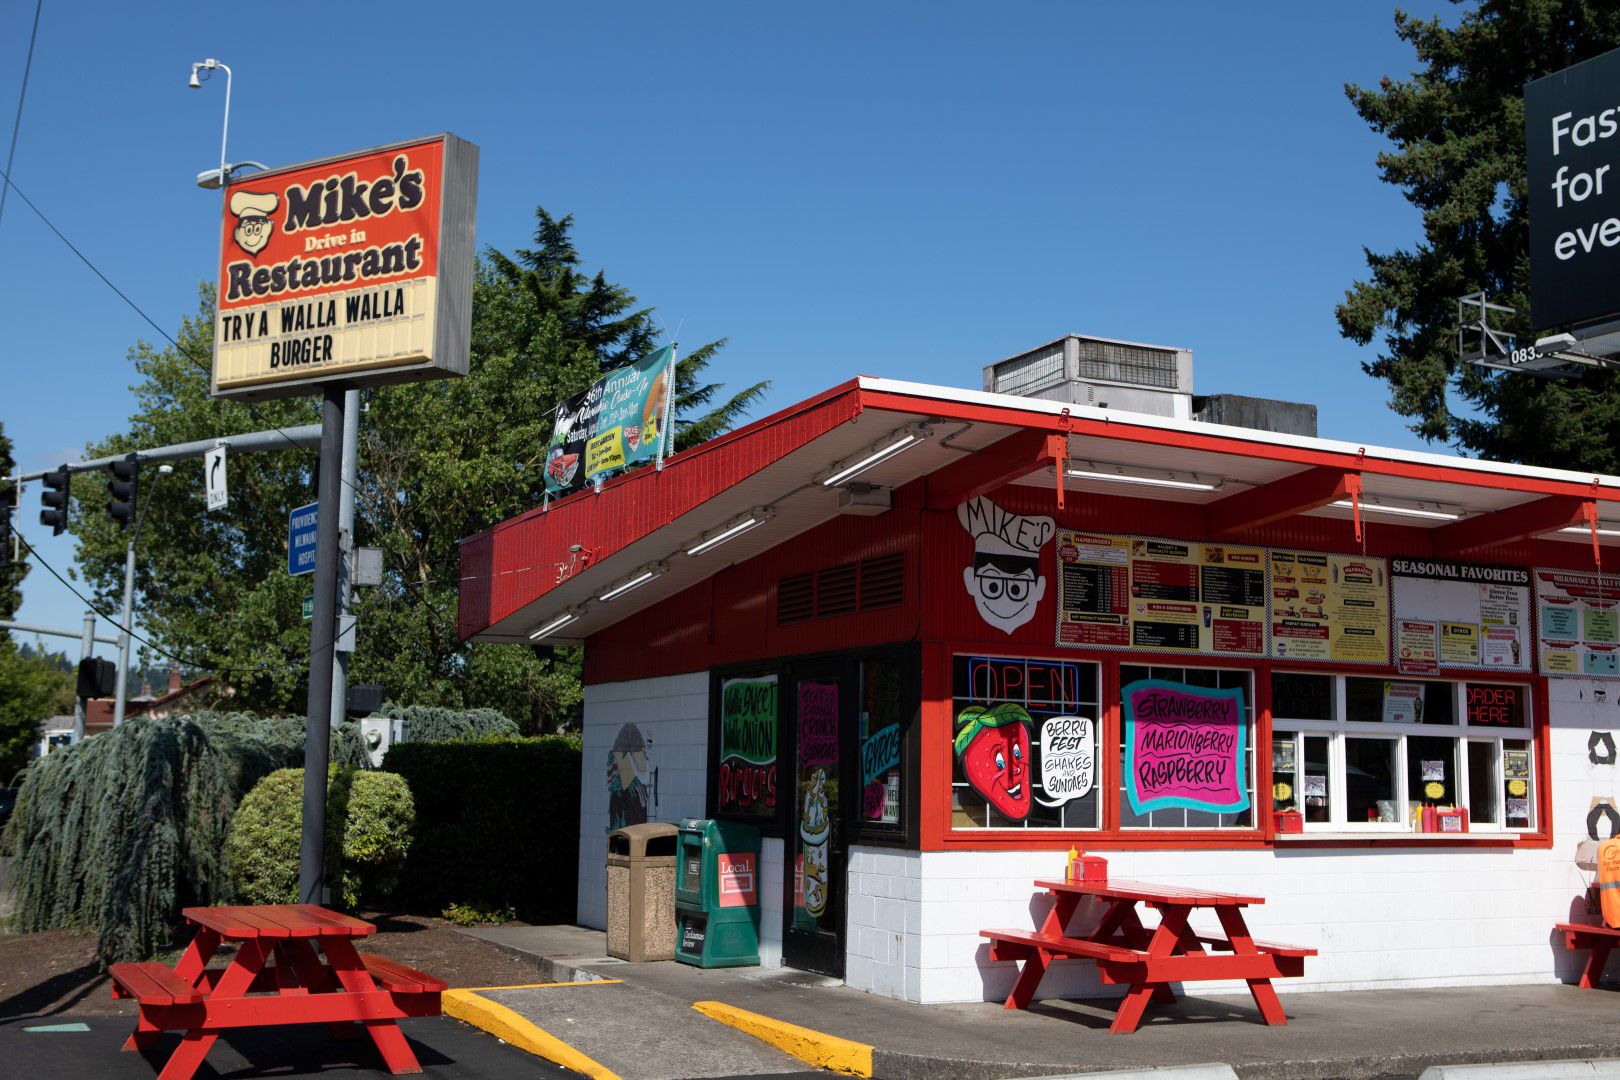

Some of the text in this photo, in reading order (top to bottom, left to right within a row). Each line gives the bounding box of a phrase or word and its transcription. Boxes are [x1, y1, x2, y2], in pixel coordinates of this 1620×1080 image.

[1552, 105, 1620, 156] Fas
[284, 154, 423, 232] Mike's
[1551, 164, 1610, 208] for
[304, 229, 366, 252] Drive in
[1554, 217, 1620, 261] eve
[227, 236, 422, 301] Restaurant
[222, 288, 404, 342] TRY A WALLA WALLA
[270, 334, 333, 368] BURGER
[603, 371, 641, 394] Annual
[291, 511, 318, 531] PROVIDENC
[966, 496, 1051, 549] MIKE'S
[298, 549, 316, 567] HOSPIT
[1392, 560, 1529, 583] SEASONAL FAVORITES
[1553, 575, 1590, 585] MILKSHAKE
[973, 663, 1074, 708] OPEN
[1137, 693, 1230, 722] STRAWBERRY
[1467, 706, 1510, 723] HERE
[1046, 720, 1088, 737] BERRY
[865, 728, 901, 775] GYROS
[1049, 736, 1086, 752] FEST
[1141, 729, 1234, 754] MARIONBERRY
[1045, 756, 1092, 772] SHAKES
[1139, 758, 1226, 790] RASPBERRY
[1048, 772, 1088, 793] SUNDAES
[887, 789, 900, 802] HEL
[883, 804, 900, 817] WANT
[720, 860, 752, 874] Local.
